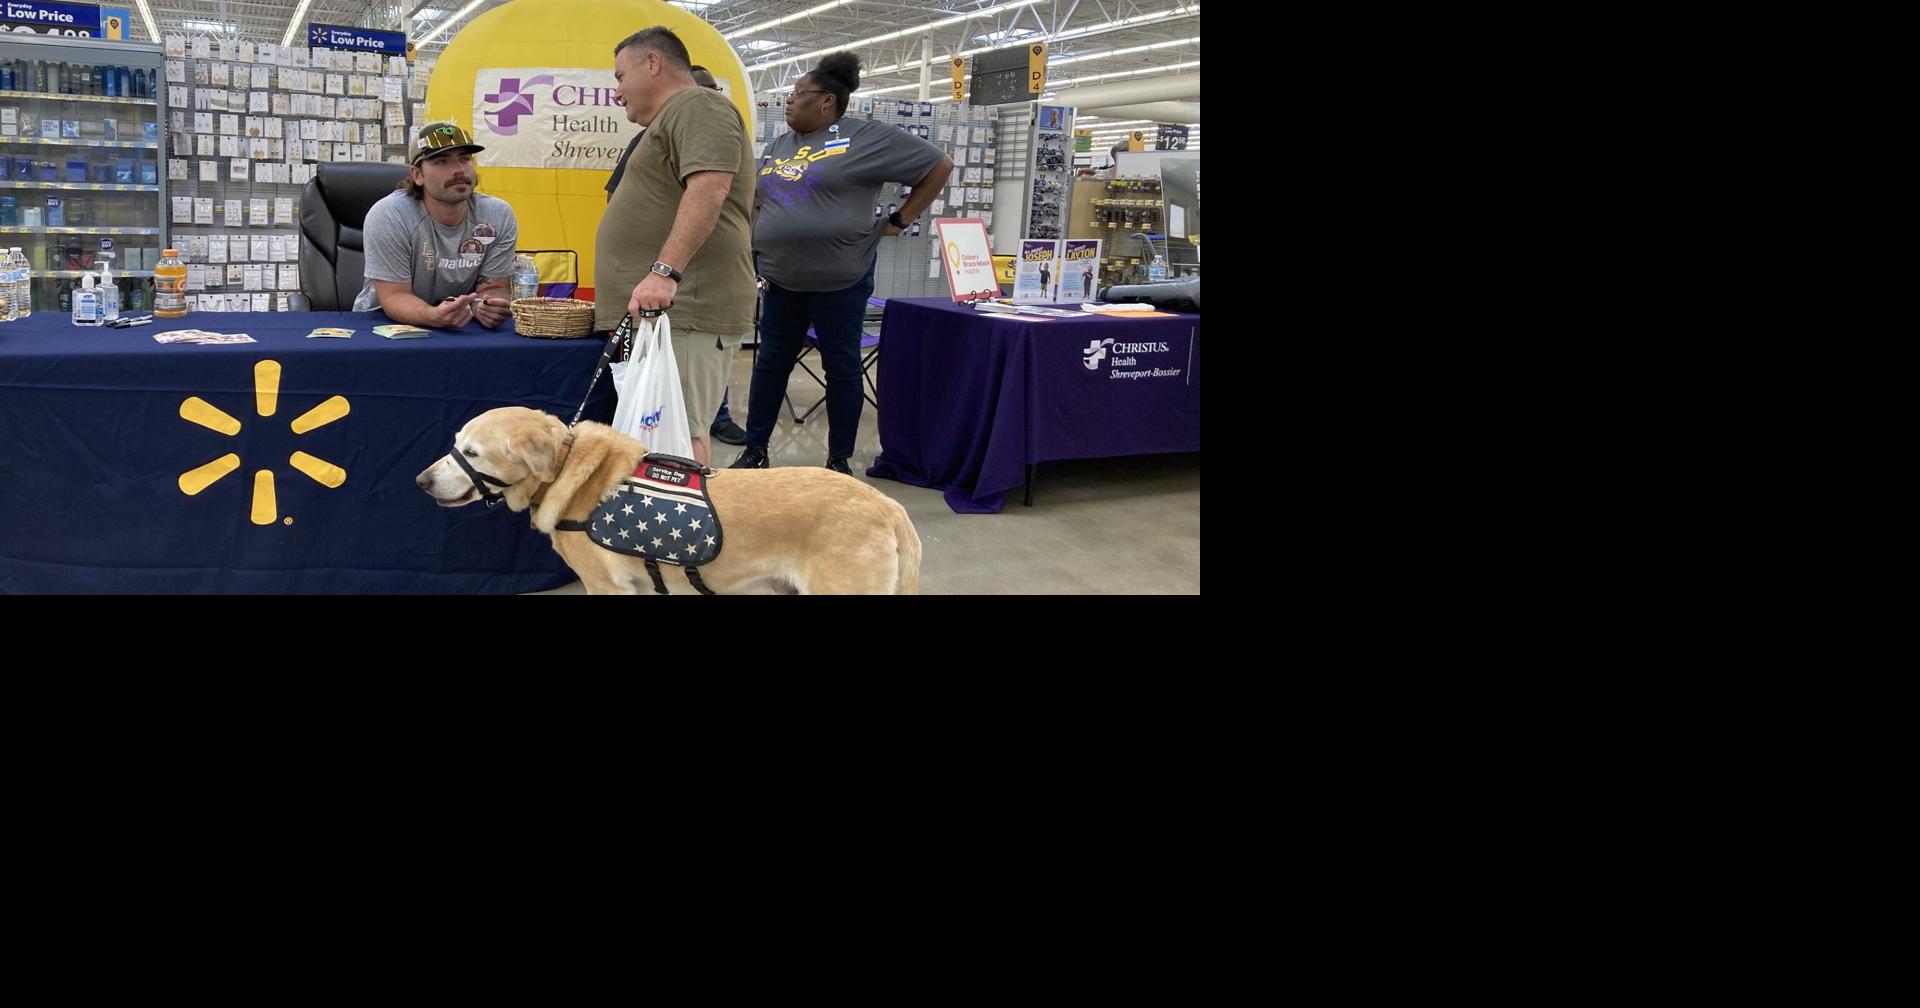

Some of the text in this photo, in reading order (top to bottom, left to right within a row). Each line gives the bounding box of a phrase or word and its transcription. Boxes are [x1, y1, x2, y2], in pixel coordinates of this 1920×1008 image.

[7, 7, 73, 22] Low Price
[331, 34, 385, 48] Low Price
[1032, 71, 1041, 80] D
[954, 81, 962, 89] D
[1032, 83, 1040, 91] 4
[956, 91, 962, 99] 5
[552, 114, 618, 133] Health
[1024, 250, 1053, 262] JOSEPH
[1066, 247, 1096, 261] LAYTON
[1111, 356, 1136, 366] Health
[1110, 367, 1181, 380] Shreveport-Bossier
[652, 466, 685, 479] Service Dog
